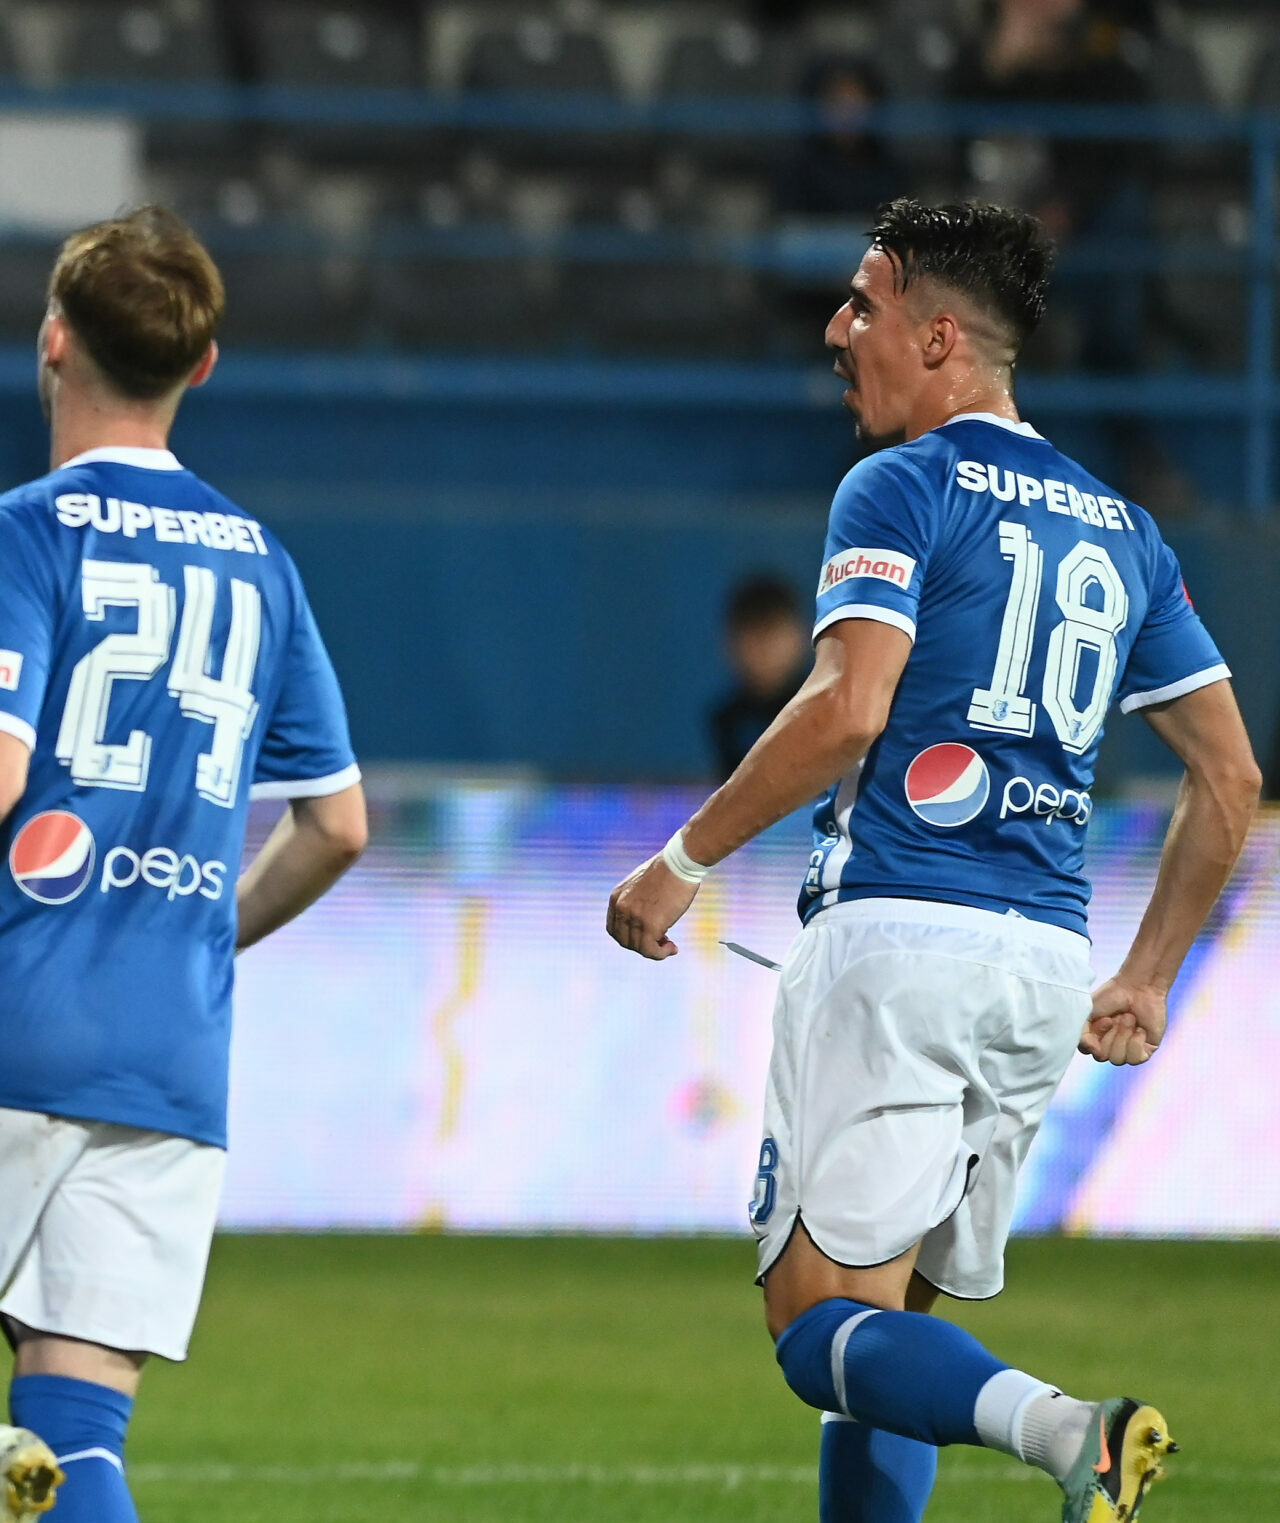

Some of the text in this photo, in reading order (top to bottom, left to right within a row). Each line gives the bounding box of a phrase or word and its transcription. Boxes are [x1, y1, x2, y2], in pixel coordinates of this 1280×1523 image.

[55, 494, 268, 555] SUPERBET
[956, 461, 1135, 531] SUPERBET
[824, 554, 906, 584] Auchan
[967, 521, 1129, 756] 18
[55, 559, 262, 809] 24
[999, 776, 1093, 826] peps
[101, 846, 227, 900] peps
